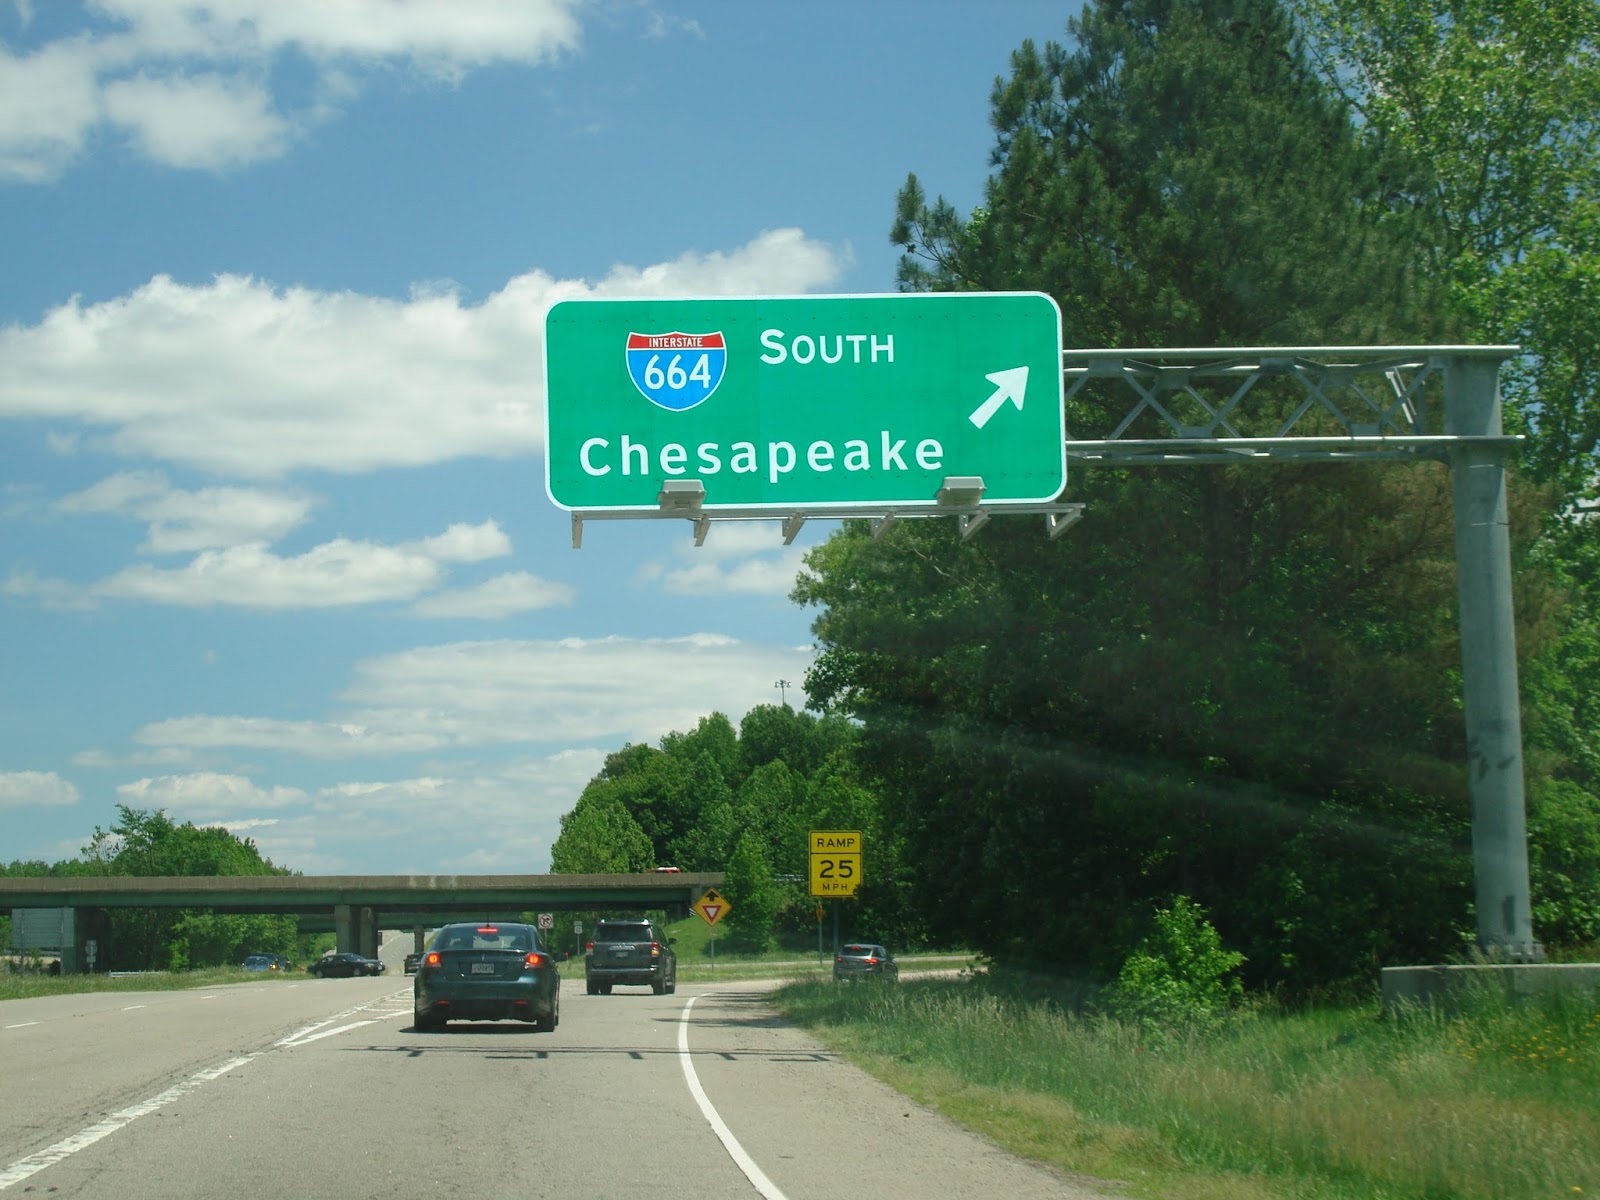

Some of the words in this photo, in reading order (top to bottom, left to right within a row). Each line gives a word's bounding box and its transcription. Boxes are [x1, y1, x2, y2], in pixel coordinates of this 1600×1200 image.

[648, 337, 704, 348] INTERSTATE
[759, 328, 895, 365] SOUTH
[644, 353, 711, 390] 664
[579, 430, 944, 484] Chesapeake
[816, 837, 855, 848] RAMP
[819, 859, 853, 878] 25
[822, 882, 848, 891] MPH
